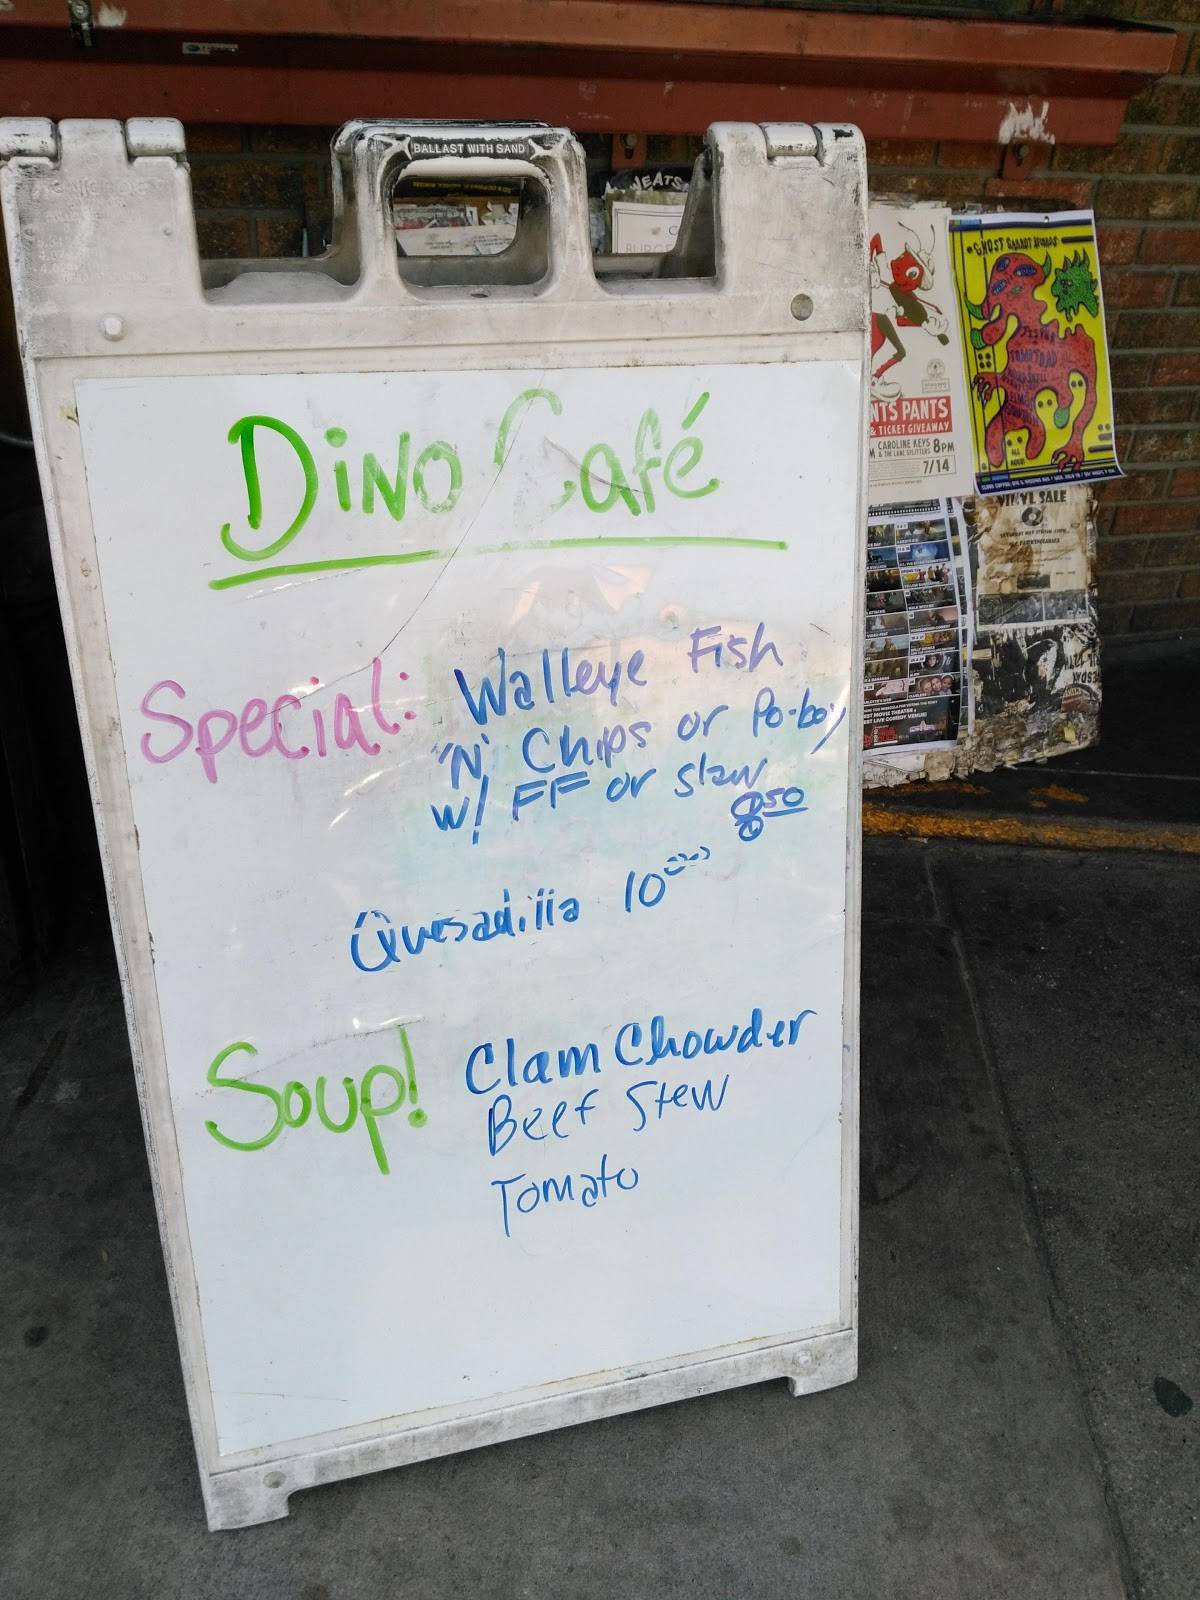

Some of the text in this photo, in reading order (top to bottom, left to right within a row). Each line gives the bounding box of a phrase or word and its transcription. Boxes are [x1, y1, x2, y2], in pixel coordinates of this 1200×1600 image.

[413, 142, 526, 154] BALLAST WITH SAND
[879, 424, 906, 435] TICKET
[909, 421, 950, 433] GIVEAWAY
[902, 398, 949, 421] PANTS
[877, 439, 911, 450] CAROLINE
[913, 438, 931, 448] KEYS
[933, 438, 955, 453] 8PM
[923, 459, 950, 474] 7/14
[1039, 489, 1067, 504] SALE
[143, 621, 783, 783] Special: Walleye Fish
[522, 725, 652, 770] Chips
[677, 705, 729, 741] or
[512, 771, 591, 822] FF
[606, 767, 657, 802] or
[675, 752, 768, 798] slaw
[205, 1008, 817, 1174] Soup! Clam Chowder
[487, 1074, 729, 1157] Beef Stew
[490, 1154, 640, 1237] Tomato
